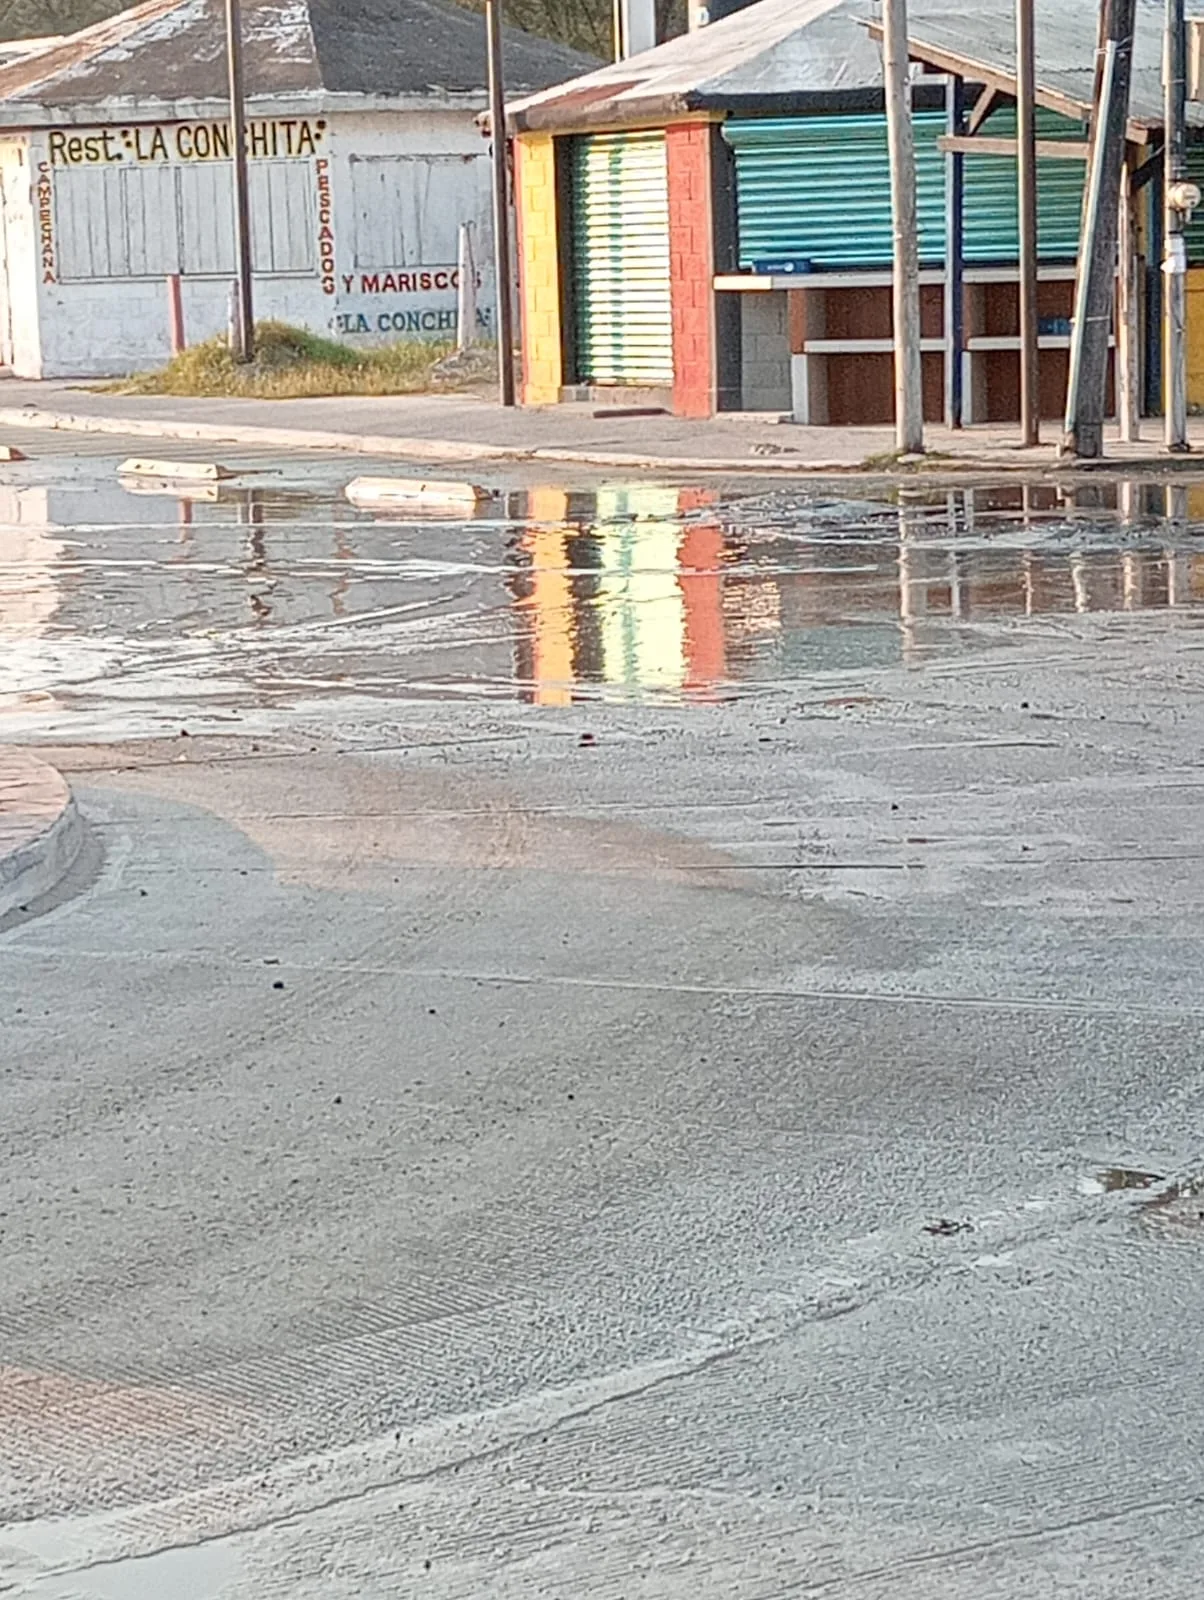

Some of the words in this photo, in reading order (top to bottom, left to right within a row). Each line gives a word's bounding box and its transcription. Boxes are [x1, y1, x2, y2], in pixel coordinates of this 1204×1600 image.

[176, 119, 317, 159] CONHITA
[37, 161, 56, 284] CAMPECHANA
[315, 158, 335, 295] PESCADOS
[342, 273, 354, 294] Y
